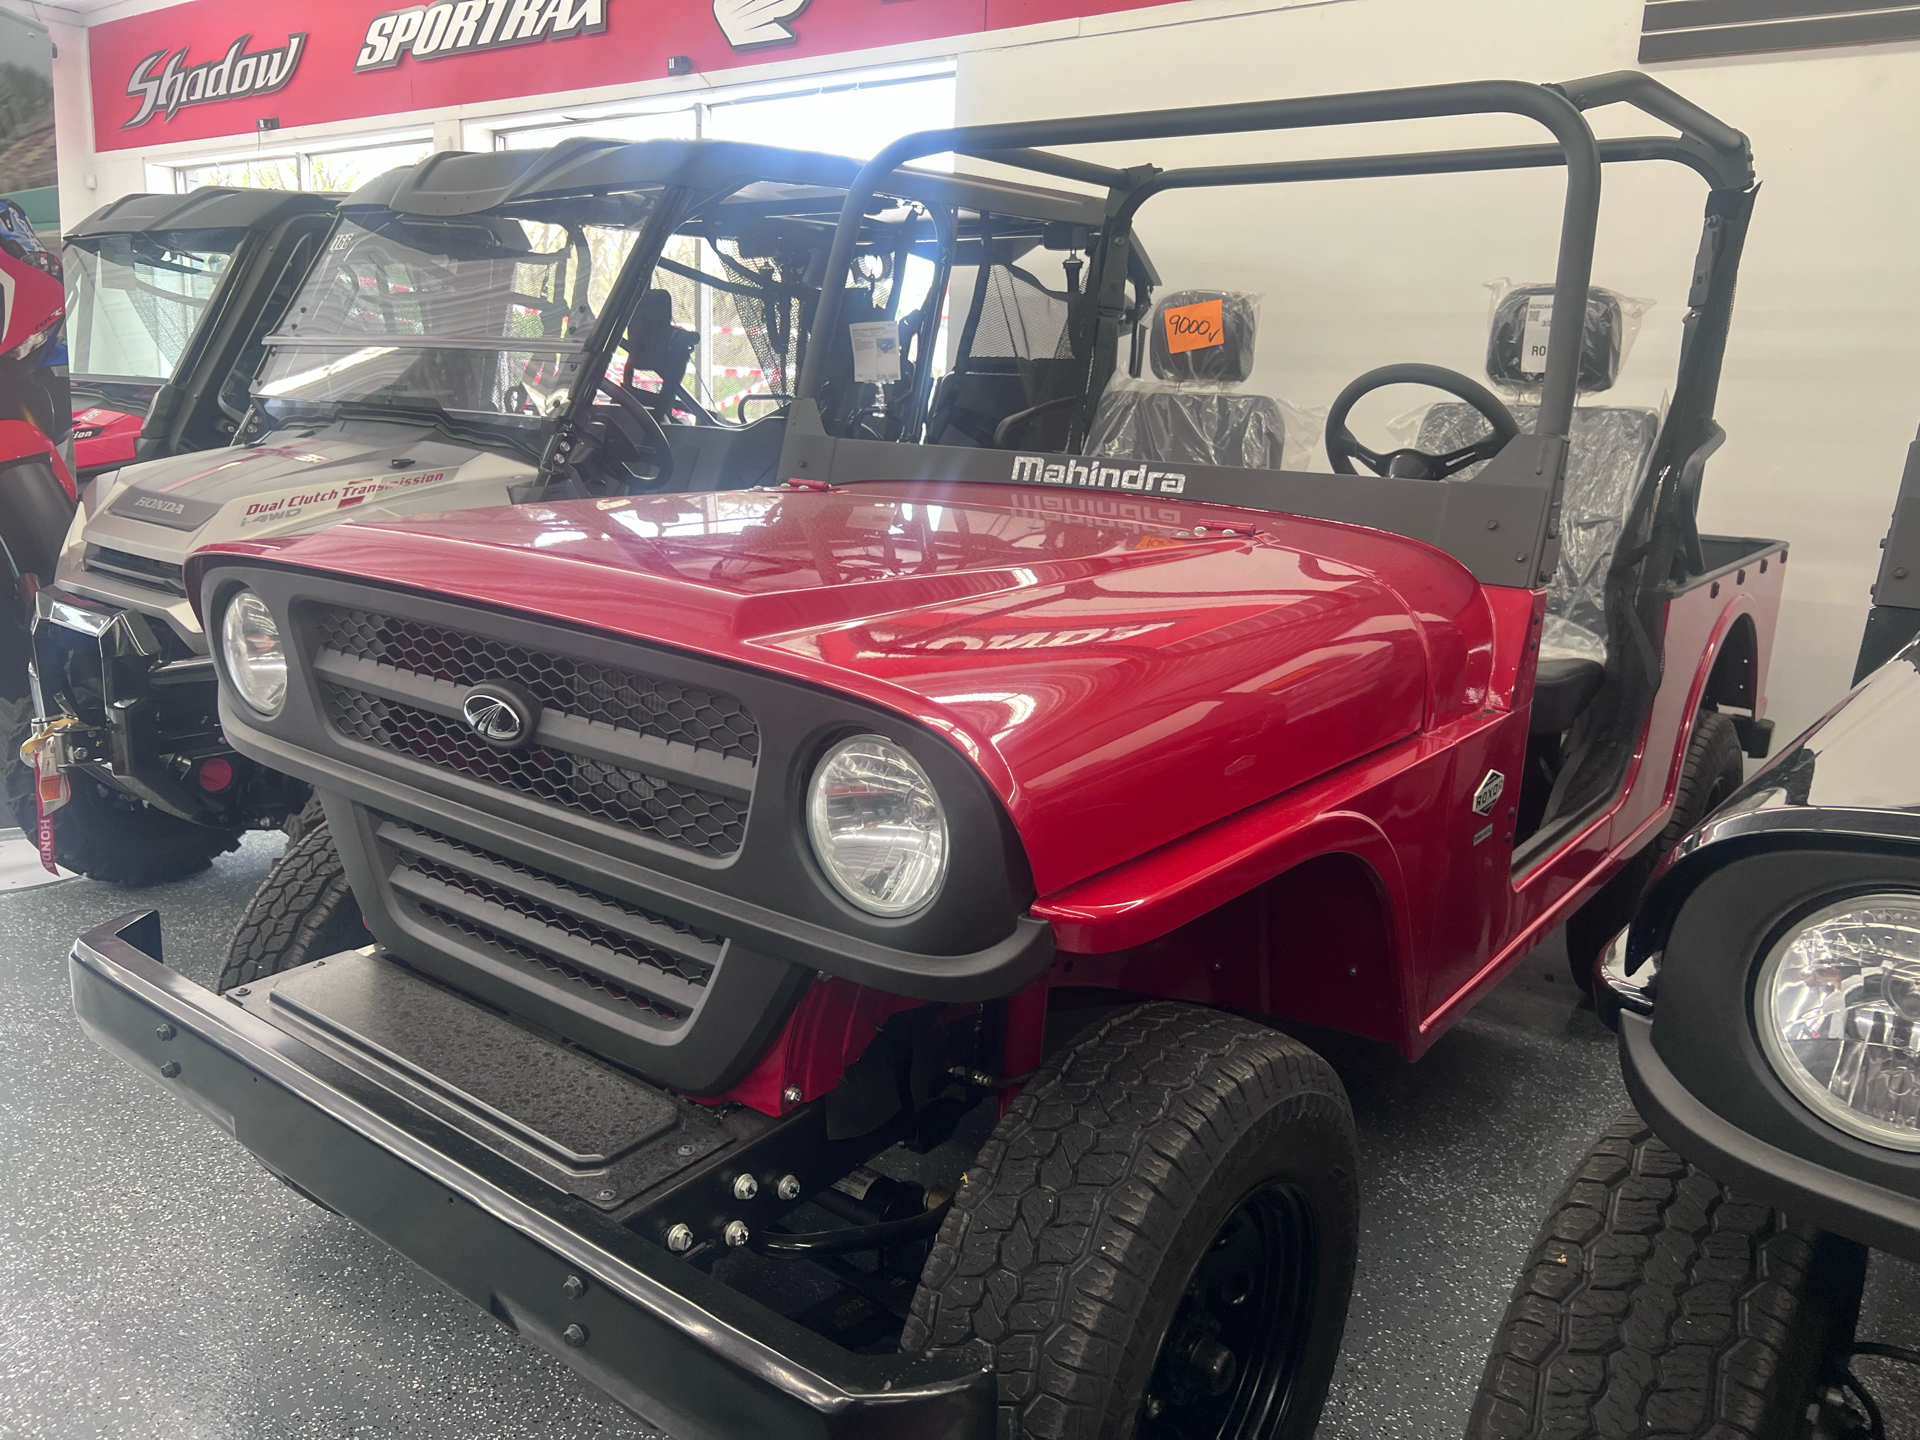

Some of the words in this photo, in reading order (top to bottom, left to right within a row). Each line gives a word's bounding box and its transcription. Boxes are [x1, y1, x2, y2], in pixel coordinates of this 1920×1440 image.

[119, 32, 305, 130] Shadow
[245, 499, 285, 516] Dual
[287, 489, 339, 508] Clutch
[341, 472, 444, 498] Transmission
[1011, 455, 1186, 494] Mahindra
[134, 496, 185, 515] HONDA
[1476, 780, 1503, 808] ROXOR
[40, 819, 54, 869] HONDA
